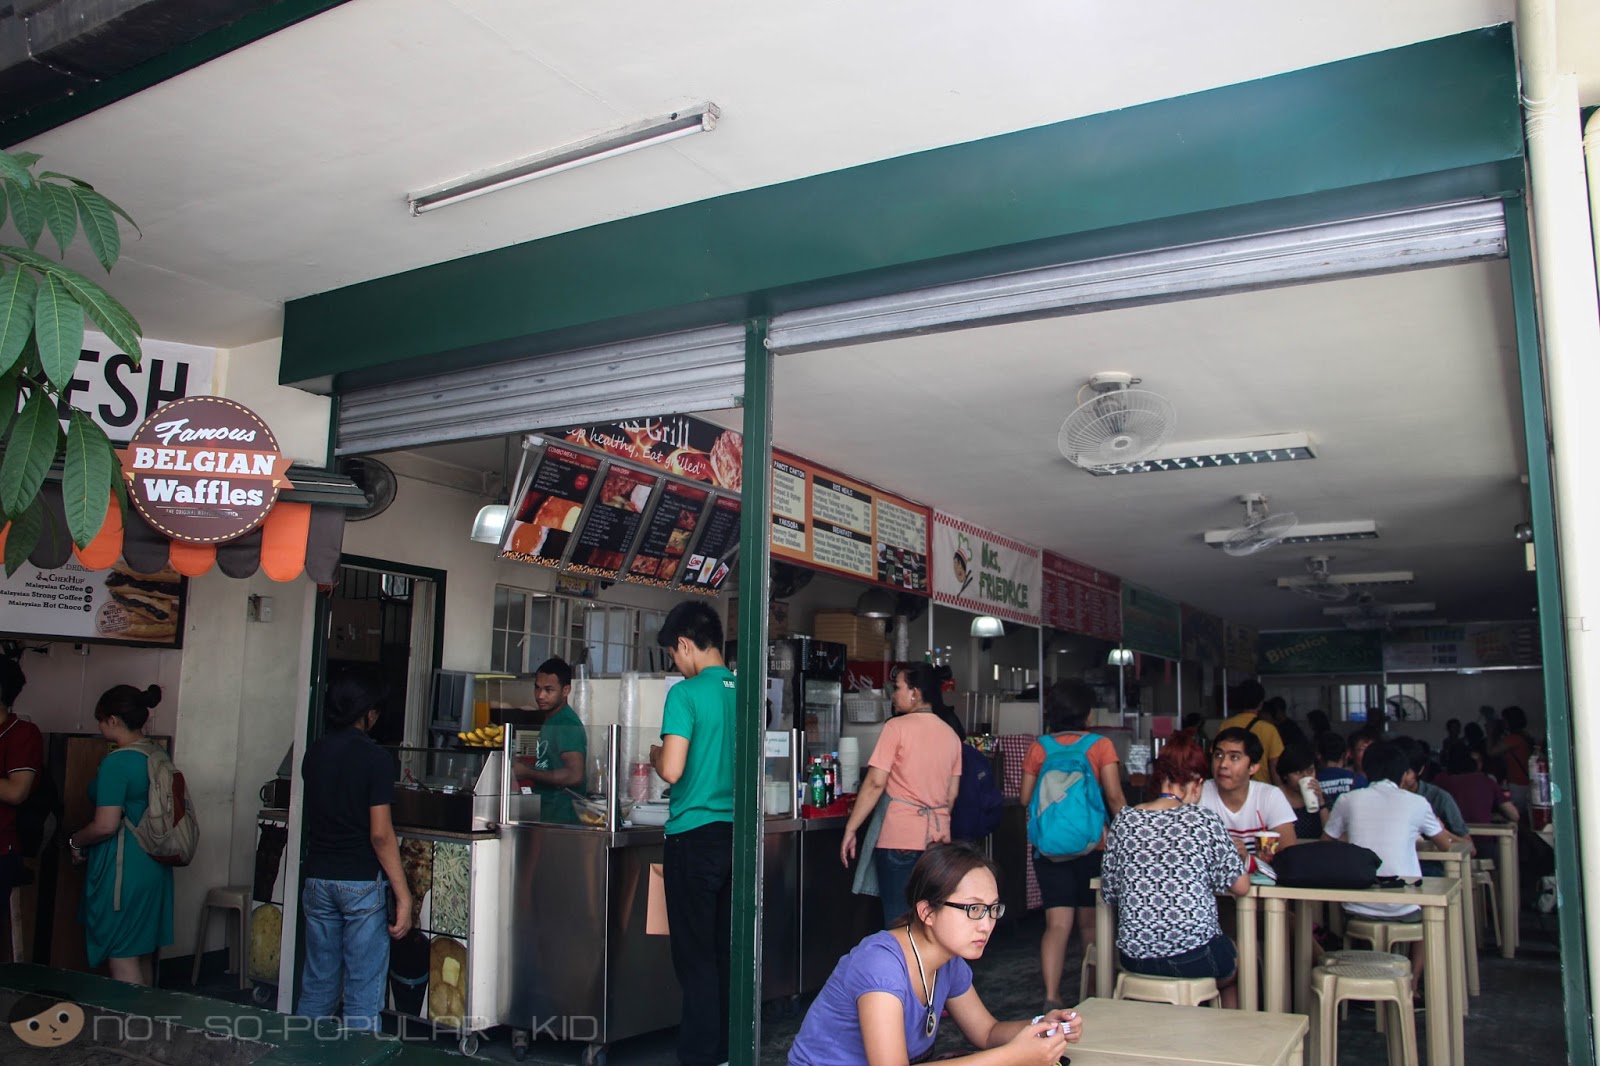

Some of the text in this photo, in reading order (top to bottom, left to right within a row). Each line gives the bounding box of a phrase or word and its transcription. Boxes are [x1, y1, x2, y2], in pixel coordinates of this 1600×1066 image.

[154, 418, 257, 446] Famous
[589, 427, 639, 458] healthy,
[642, 446, 664, 462] Eat
[645, 416, 690, 450] Grill
[132, 447, 276, 476] BELGIAN
[143, 478, 264, 507] Waffles
[32, 591, 57, 600] Strong
[58, 594, 83, 602] Coffee
[59, 584, 84, 592] Coffee
[58, 603, 82, 611] Choco
